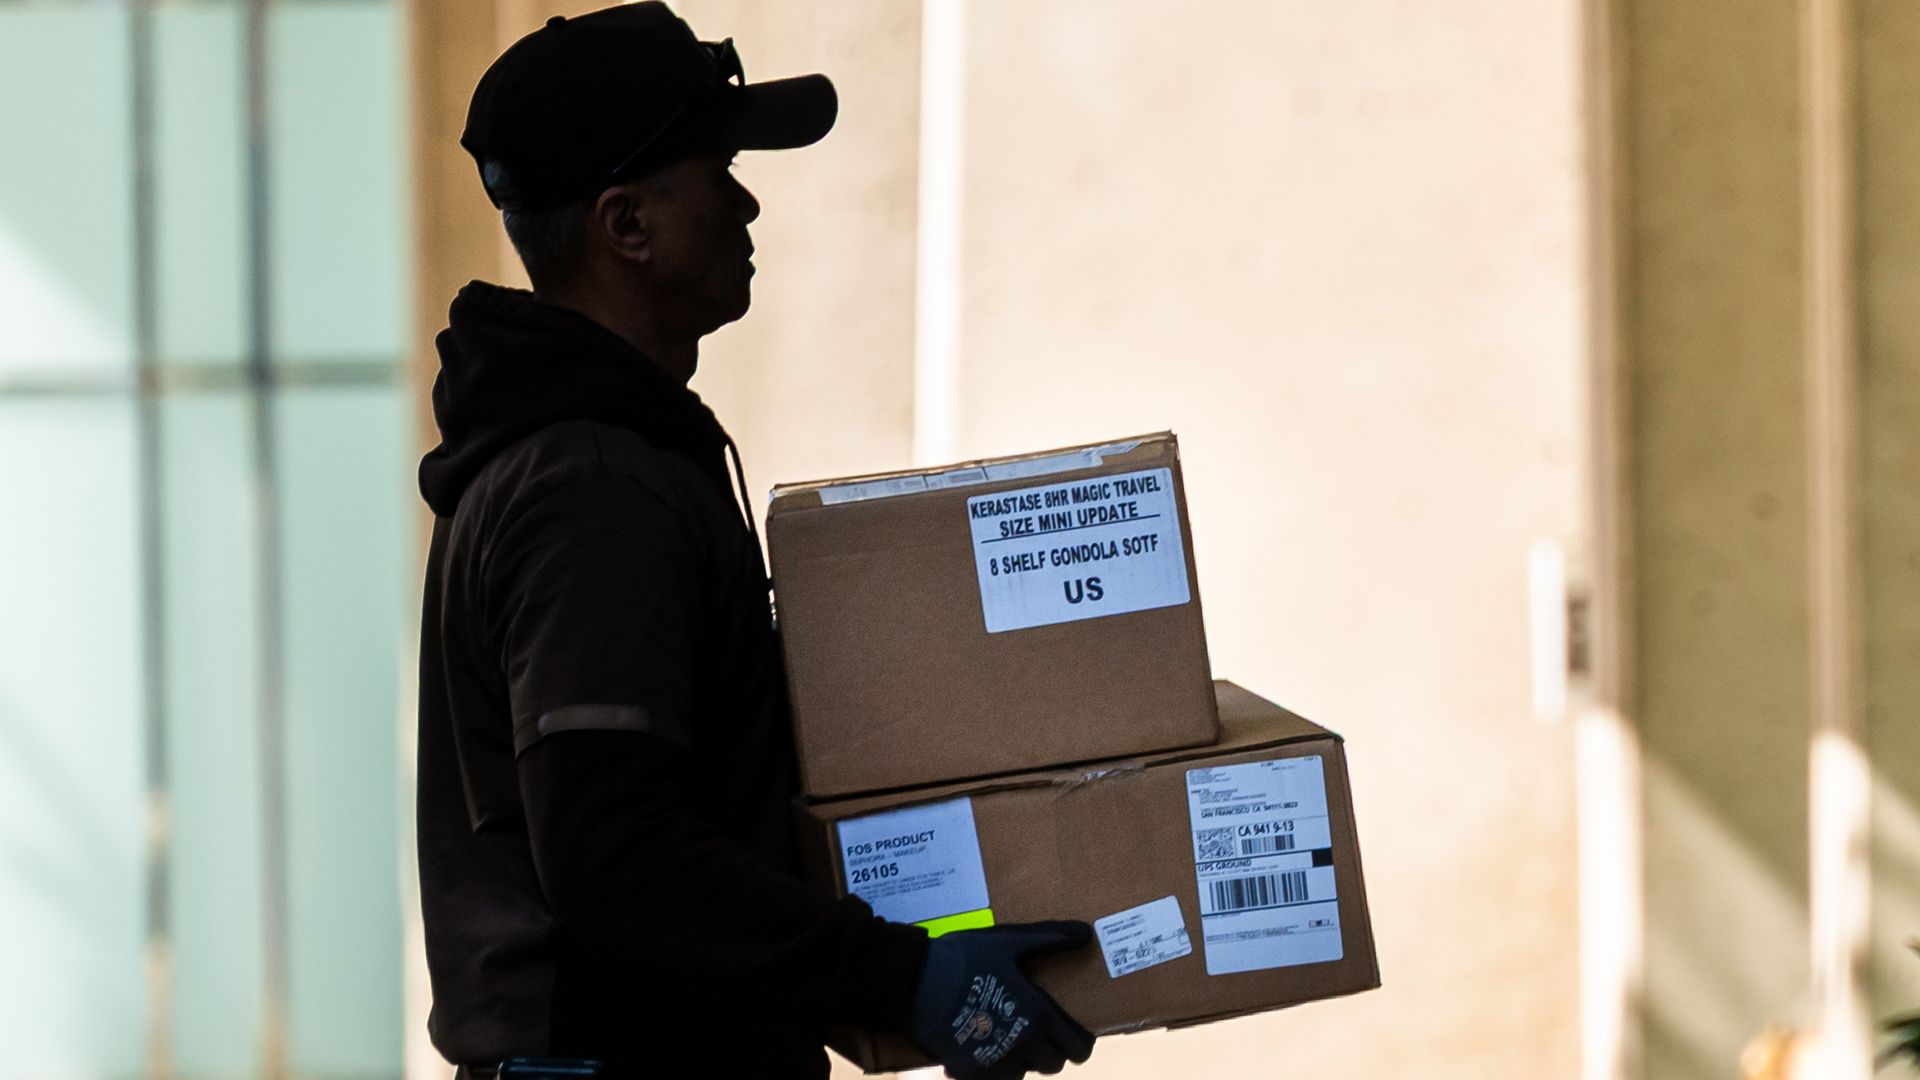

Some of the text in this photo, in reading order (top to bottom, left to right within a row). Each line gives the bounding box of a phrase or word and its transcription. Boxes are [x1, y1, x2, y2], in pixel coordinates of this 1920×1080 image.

[970, 475, 1161, 520] KERASTASE 8HR MAGIC TRAVEL
[999, 501, 1138, 537] SIZE MINI UPDATE
[990, 534, 1158, 576] 8 SHELF GONDOLA SOTF
[1064, 576, 1104, 604] US
[1238, 820, 1295, 837] CA 941 9-13
[847, 830, 935, 857] FOS PRODUCT
[851, 862, 899, 884] 26105
[1216, 859, 1252, 869] GROUND
